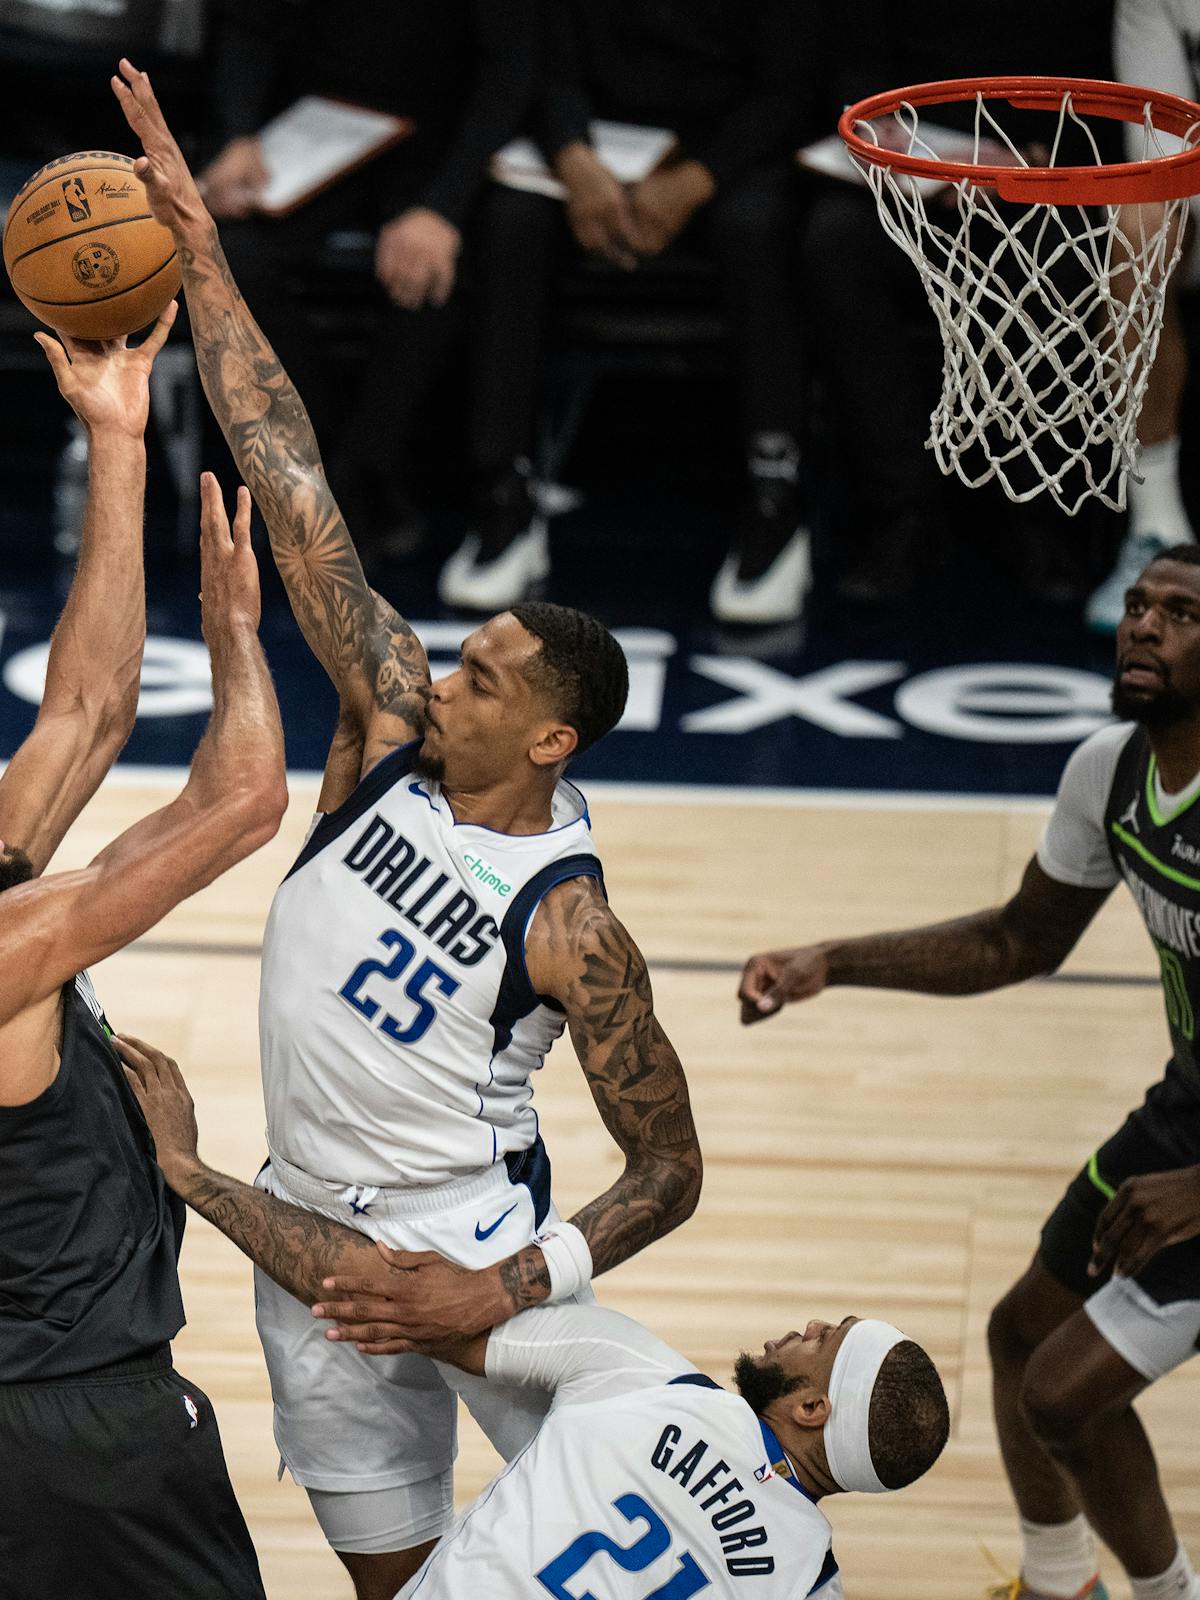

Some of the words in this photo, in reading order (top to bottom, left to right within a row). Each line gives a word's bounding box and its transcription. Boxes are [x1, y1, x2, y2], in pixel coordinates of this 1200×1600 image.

[405, 621, 1113, 744] ixe
[341, 812, 501, 968] DALLAS
[464, 854, 511, 897] chime
[337, 927, 462, 1045] 25
[650, 1423, 775, 1577] GAFFORD
